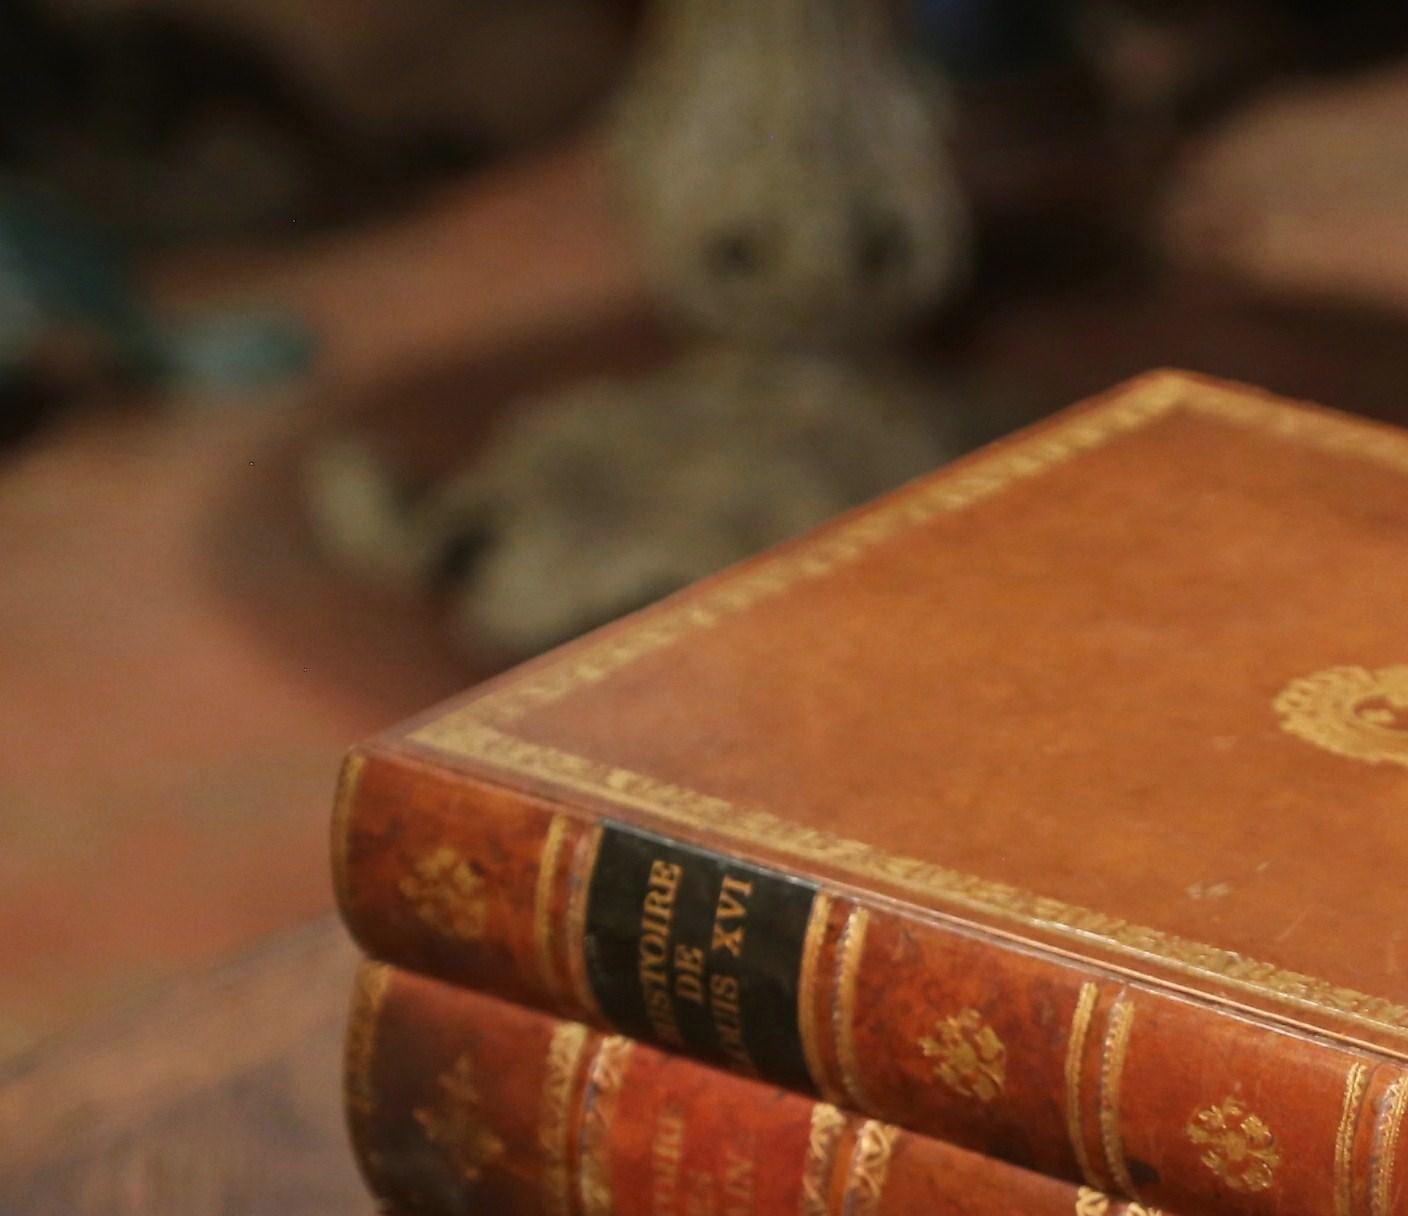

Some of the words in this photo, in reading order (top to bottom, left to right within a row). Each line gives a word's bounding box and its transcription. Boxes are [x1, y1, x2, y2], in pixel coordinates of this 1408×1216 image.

[710, 875, 752, 958] XVI
[674, 945, 704, 1005] DE
[709, 973, 753, 1070] OUIS
